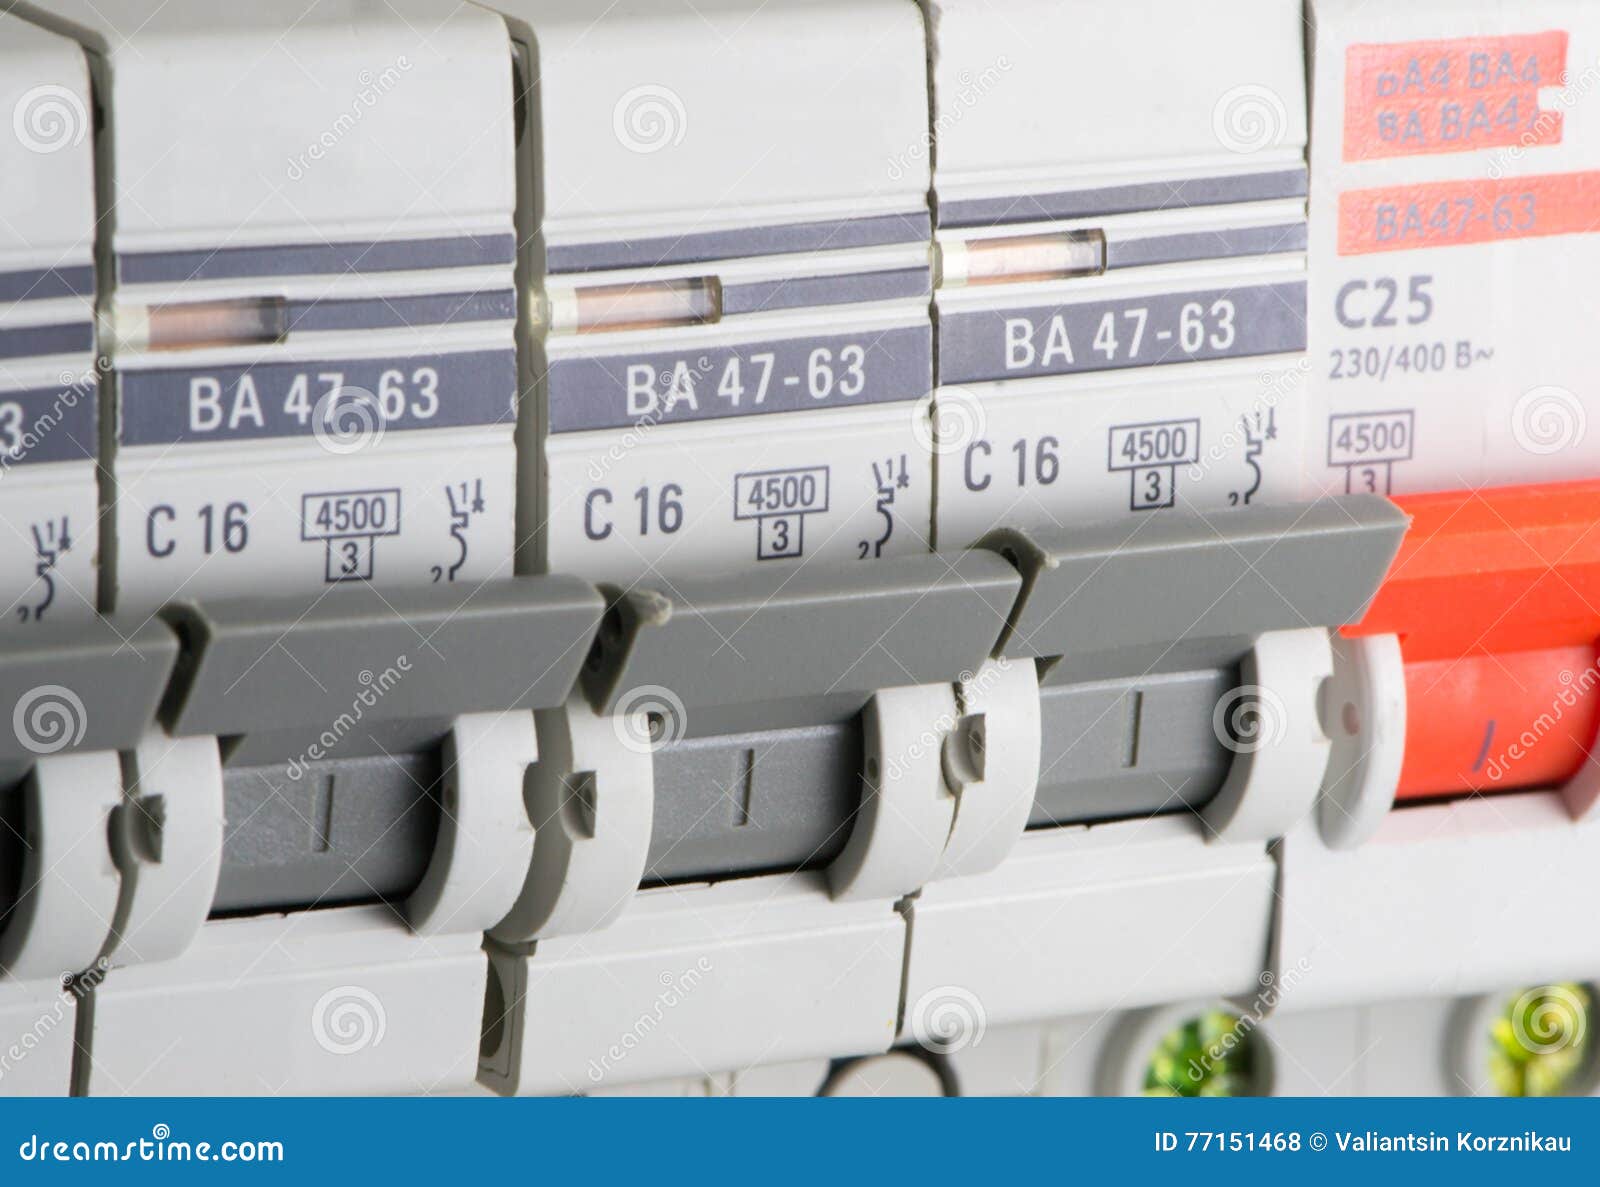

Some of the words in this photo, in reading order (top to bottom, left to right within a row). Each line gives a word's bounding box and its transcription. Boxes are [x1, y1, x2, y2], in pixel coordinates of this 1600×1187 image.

[1375, 193, 1537, 241] BA47-63
[1335, 275, 1433, 329] C25
[1005, 315, 1074, 370] BA
[1092, 299, 1235, 361] 47-63
[626, 360, 698, 416] BA
[717, 344, 865, 407] 47-63
[1329, 342, 1446, 382] 230/400
[189, 376, 264, 432] BA
[284, 368, 439, 425] 47-63
[1122, 427, 1187, 462] 4500
[1336, 421, 1406, 453] 4500
[964, 440, 992, 491] C
[1012, 436, 1059, 486] 16
[748, 474, 816, 510] 4500
[1145, 471, 1161, 502] 3
[146, 505, 175, 557] C
[198, 502, 248, 554] 16
[316, 497, 386, 531] 4500
[584, 488, 613, 541] C
[634, 483, 683, 536] 16
[772, 520, 789, 551] 3
[341, 542, 359, 574] 3
